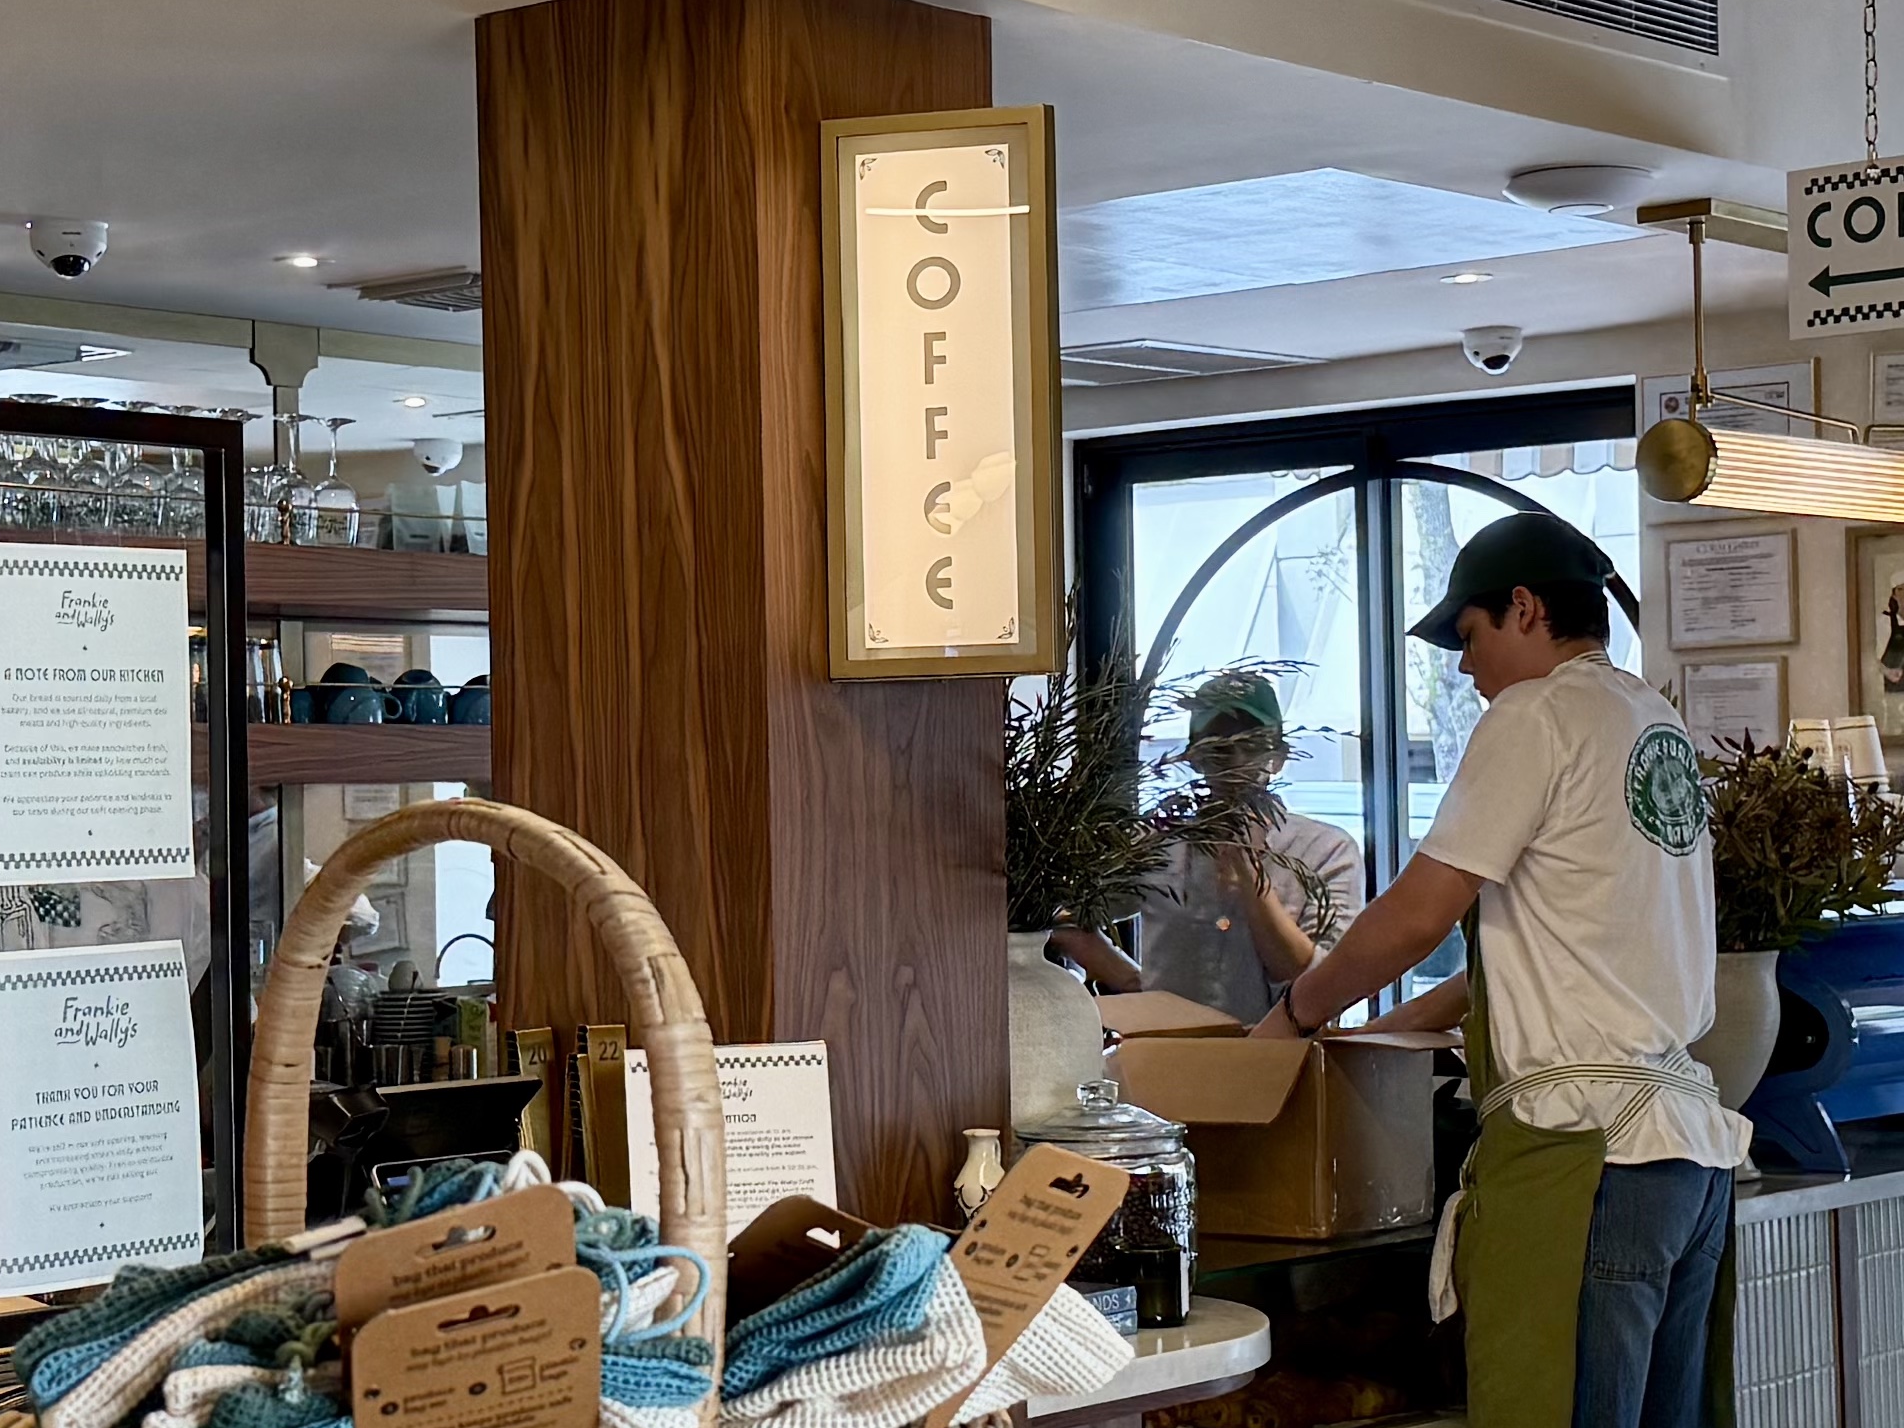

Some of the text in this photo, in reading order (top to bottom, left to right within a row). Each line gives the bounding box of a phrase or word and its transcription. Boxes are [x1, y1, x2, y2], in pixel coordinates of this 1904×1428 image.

[906, 179, 961, 611] COFFEE
[61, 590, 109, 609] Frankie
[55, 609, 115, 632] and Wally's
[4, 667, 164, 683] A NOTE FROM OUR KITCHEN
[63, 995, 129, 1022] Frankie
[54, 1018, 138, 1048] and Wally's
[598, 1040, 620, 1062] 22
[36, 1080, 159, 1105] THANK YOU FOR YOUR
[11, 1100, 181, 1131] PATIENCE AND UNDERSTANDING
[1091, 1293, 1121, 1312] NDS
